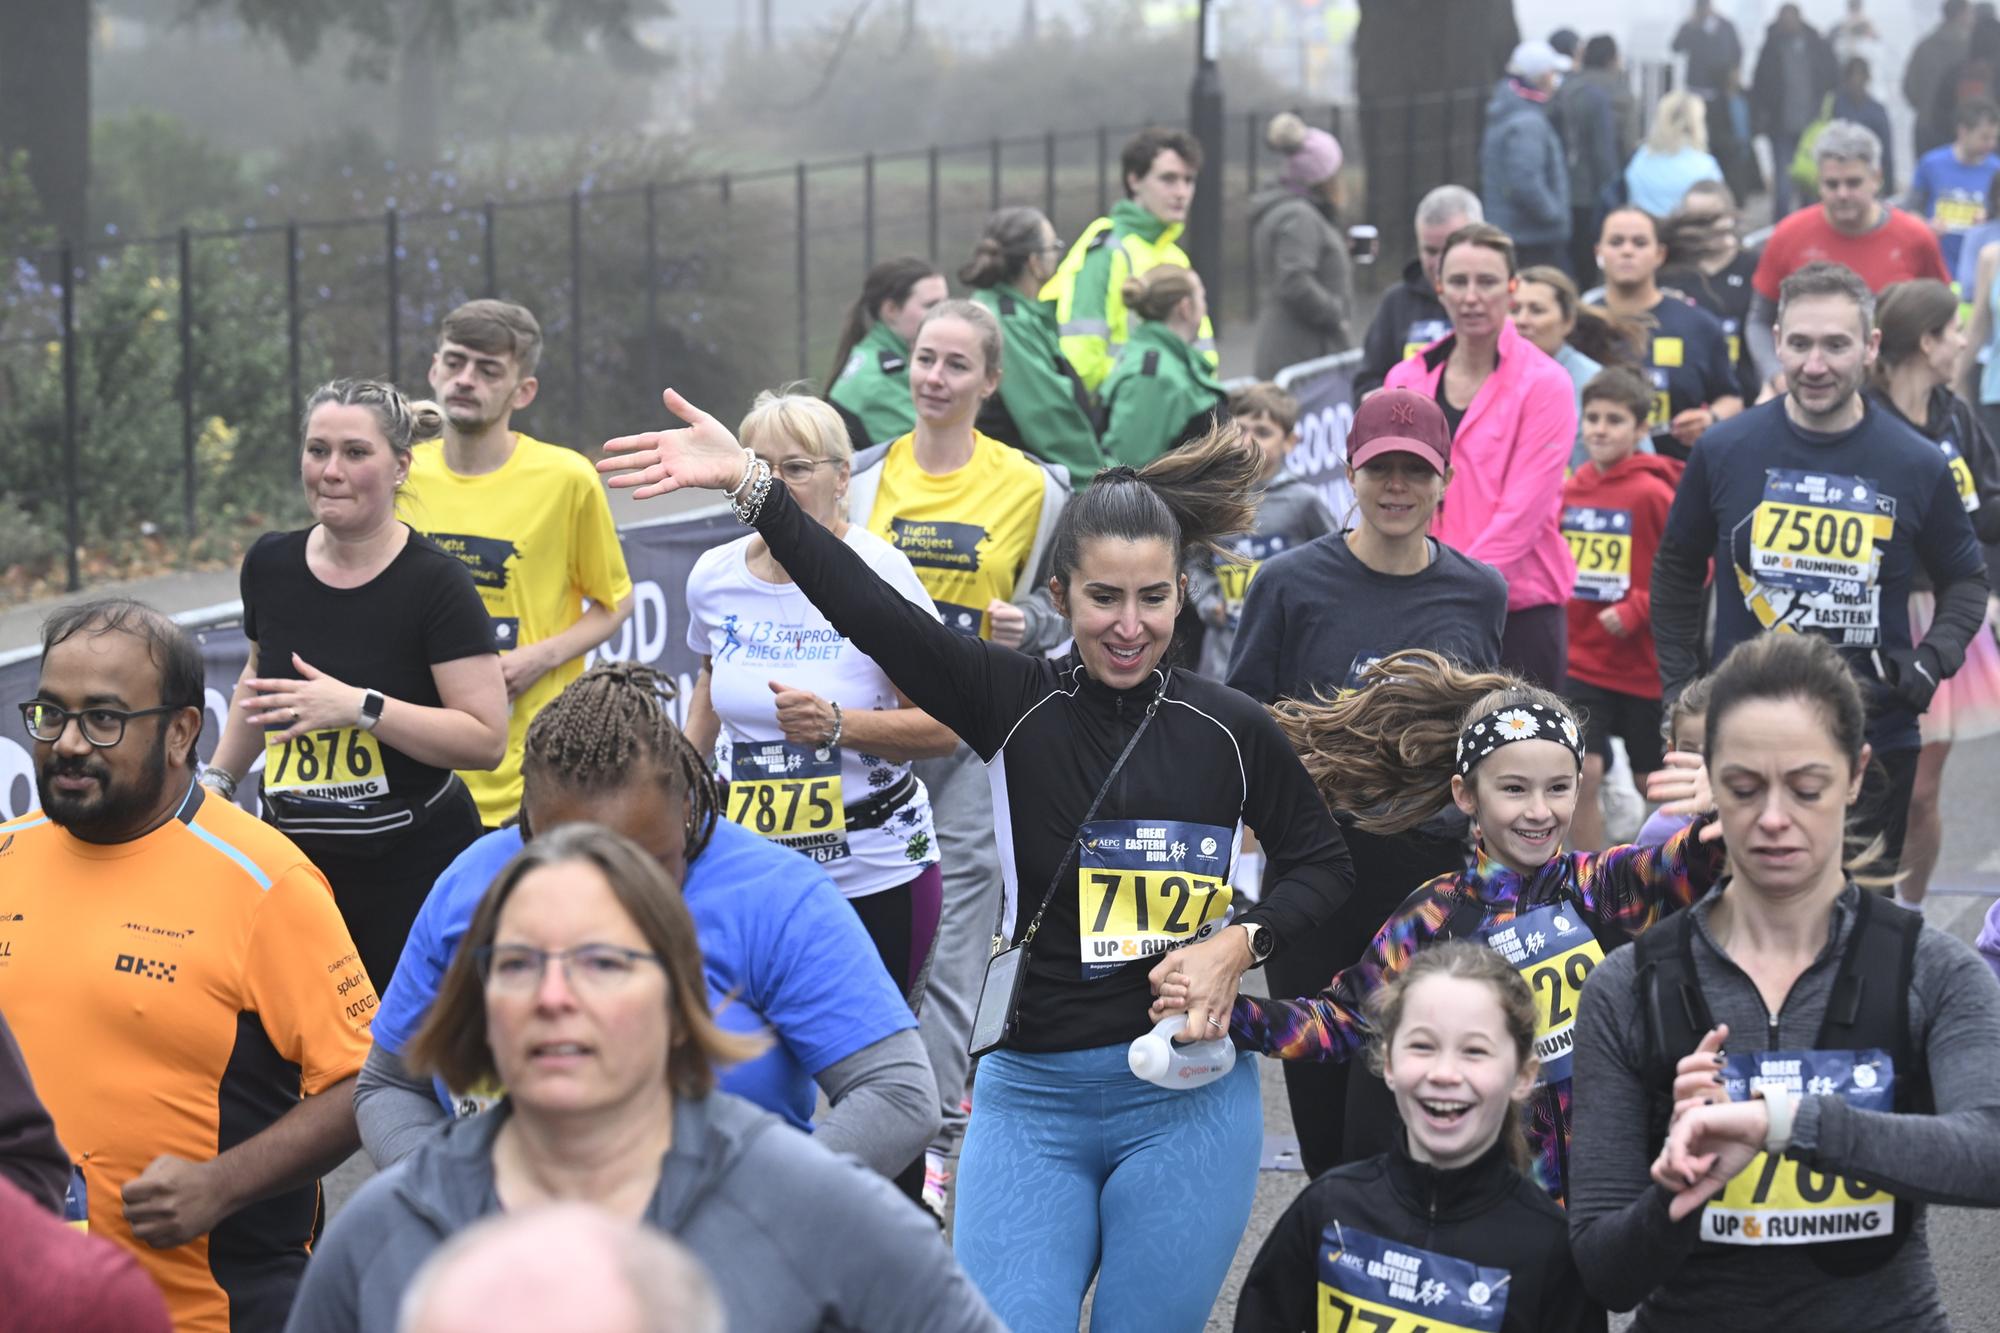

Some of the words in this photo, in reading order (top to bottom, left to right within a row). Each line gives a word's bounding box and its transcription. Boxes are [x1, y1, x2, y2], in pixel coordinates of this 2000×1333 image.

[904, 525, 937, 537] light
[1764, 508, 1863, 558] 7500
[901, 537, 953, 550] project
[1567, 536, 1622, 571] 759
[1762, 555, 1780, 567] UP
[1795, 558, 1859, 577] RUNNING
[1828, 579, 1861, 597] 7500
[1815, 608, 1873, 625] EASTERN
[749, 621, 773, 642] 13
[774, 629, 846, 643] SANPROB
[1843, 628, 1875, 644] RUN
[745, 644, 781, 660] BIEG
[783, 645, 843, 661] KOBIET
[272, 728, 373, 783] 7876
[735, 780, 833, 833] 7875
[1136, 827, 1167, 839] GREAT
[1098, 839, 1120, 847] AEPG
[1125, 838, 1167, 850] EASTERN
[808, 845, 844, 862] 7875
[1146, 850, 1167, 862] RUN
[1091, 873, 1219, 933] 7127
[121, 921, 185, 940] McLaren
[1487, 926, 1518, 949] GREAT
[1093, 940, 1119, 957] UP
[1761, 1060, 1802, 1076] GREAT
[1712, 1214, 1739, 1237] UP
[1743, 1215, 1762, 1239] &
[1767, 1210, 1881, 1238] RUNNING
[1383, 1250, 1422, 1271] GREAT
[1367, 1260, 1419, 1287] EASTERN
[1388, 1282, 1418, 1303] RUN
